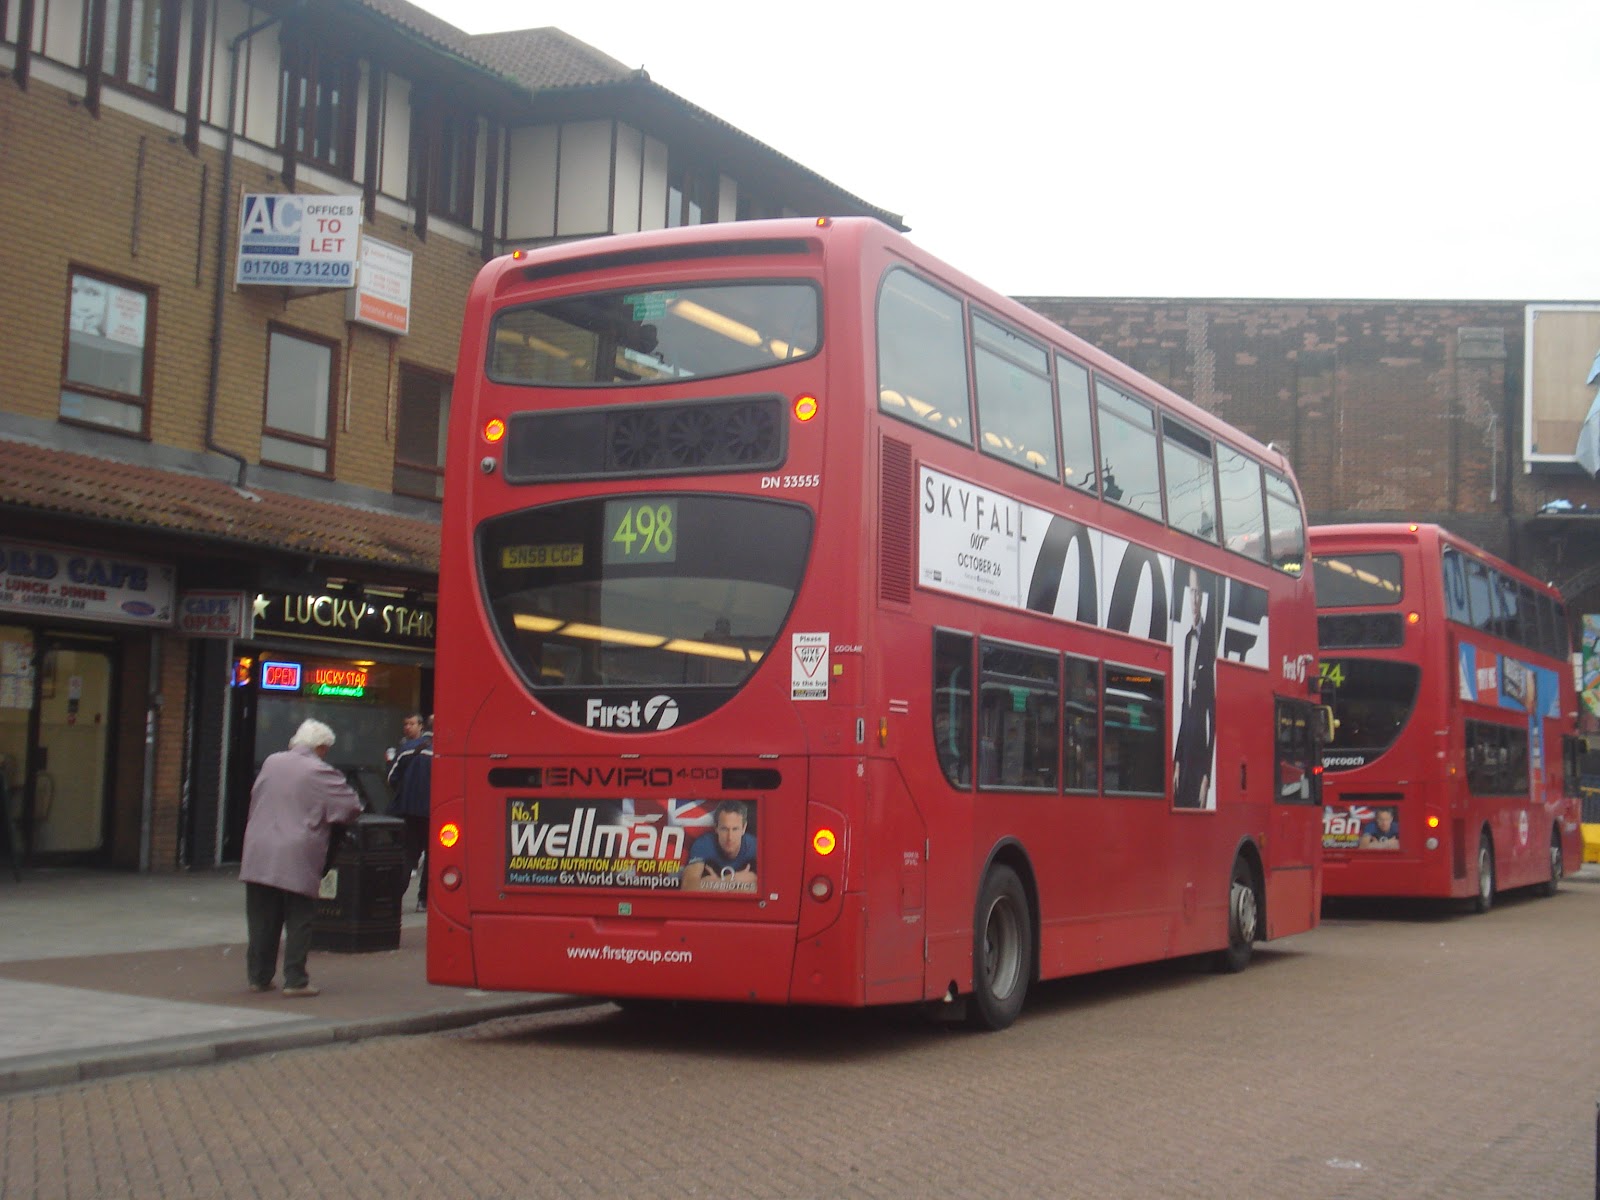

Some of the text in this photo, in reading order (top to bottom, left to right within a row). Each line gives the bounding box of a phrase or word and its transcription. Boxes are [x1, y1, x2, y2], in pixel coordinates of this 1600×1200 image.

[244, 197, 301, 233] AC
[307, 205, 353, 216] OFFICES
[317, 219, 342, 234] TO
[310, 238, 345, 253] LET
[243, 261, 289, 275] 01708
[294, 262, 350, 277] 731200
[761, 475, 819, 489] DN 33555
[925, 476, 1027, 542] SKYFALL
[612, 504, 673, 555] 498
[509, 550, 546, 564] SN58
[958, 552, 991, 574] OCTOBER
[993, 562, 1002, 577] 26
[68, 556, 148, 592] CAFE
[6, 578, 50, 595] LUNCH
[60, 585, 106, 602] DINNER
[284, 595, 434, 638] LUCKY STAR
[800, 635, 822, 643] Please
[801, 648, 819, 656] GIVE
[801, 655, 820, 663] WAY
[267, 667, 297, 686] OPEN
[316, 669, 368, 687] LUCKY STAR
[1318, 663, 1345, 687] 74
[586, 698, 641, 728] First
[545, 767, 719, 788] ENVIRO 400
[509, 857, 680, 873] ADVANCED NUTRITION JUST FOR MEN
[509, 872, 680, 890] Mark Foster 6x World Champion
[700, 881, 756, 890] VITABIOTICS
[567, 946, 692, 964] www.firstgroup.com
